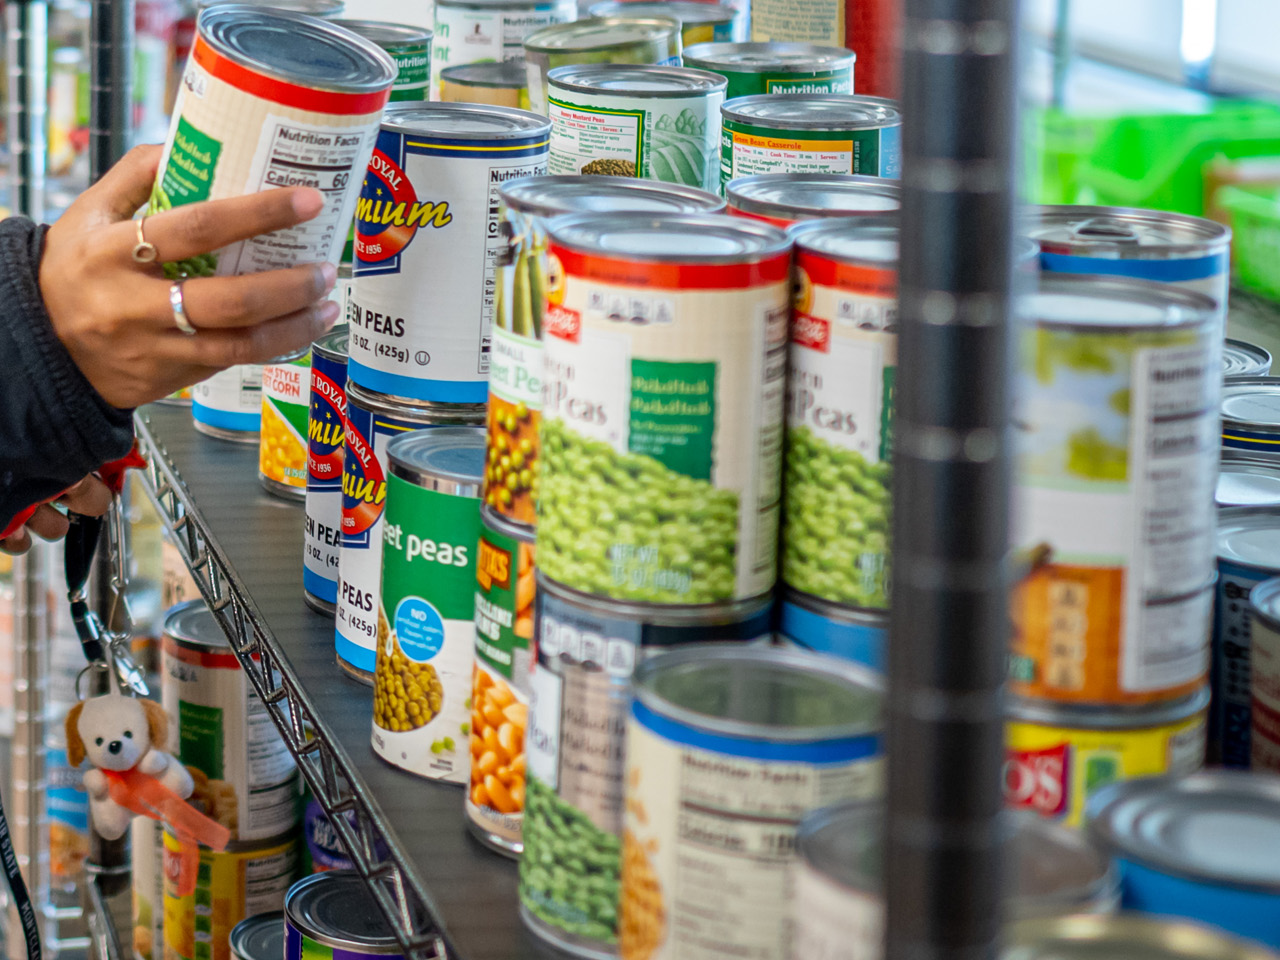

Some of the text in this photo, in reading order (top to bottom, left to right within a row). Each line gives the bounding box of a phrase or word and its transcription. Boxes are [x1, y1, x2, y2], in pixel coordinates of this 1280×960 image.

[772, 84, 828, 95] Nutrition
[572, 113, 591, 122] Mustard
[279, 128, 360, 146] Nutrition Facts
[734, 134, 802, 150] Green Bean Casserole
[273, 149, 298, 160] Serving
[267, 171, 349, 187] Calories 60
[491, 169, 532, 183] Nutrition
[365, 310, 405, 337] PEAS
[360, 336, 371, 352] OZ.
[375, 342, 410, 363] (425g)
[275, 368, 301, 383] STYLE
[272, 381, 301, 398] CORN
[316, 378, 347, 416] ROYAL
[317, 463, 332, 473] 1936
[317, 523, 340, 547] PEA
[312, 548, 323, 562] OZ.
[326, 554, 339, 568] (42
[406, 534, 468, 567] peas
[342, 581, 373, 612] PEAS
[410, 608, 427, 621] NO
[348, 614, 377, 638] (425g)
[1, 837, 20, 879] STATE
